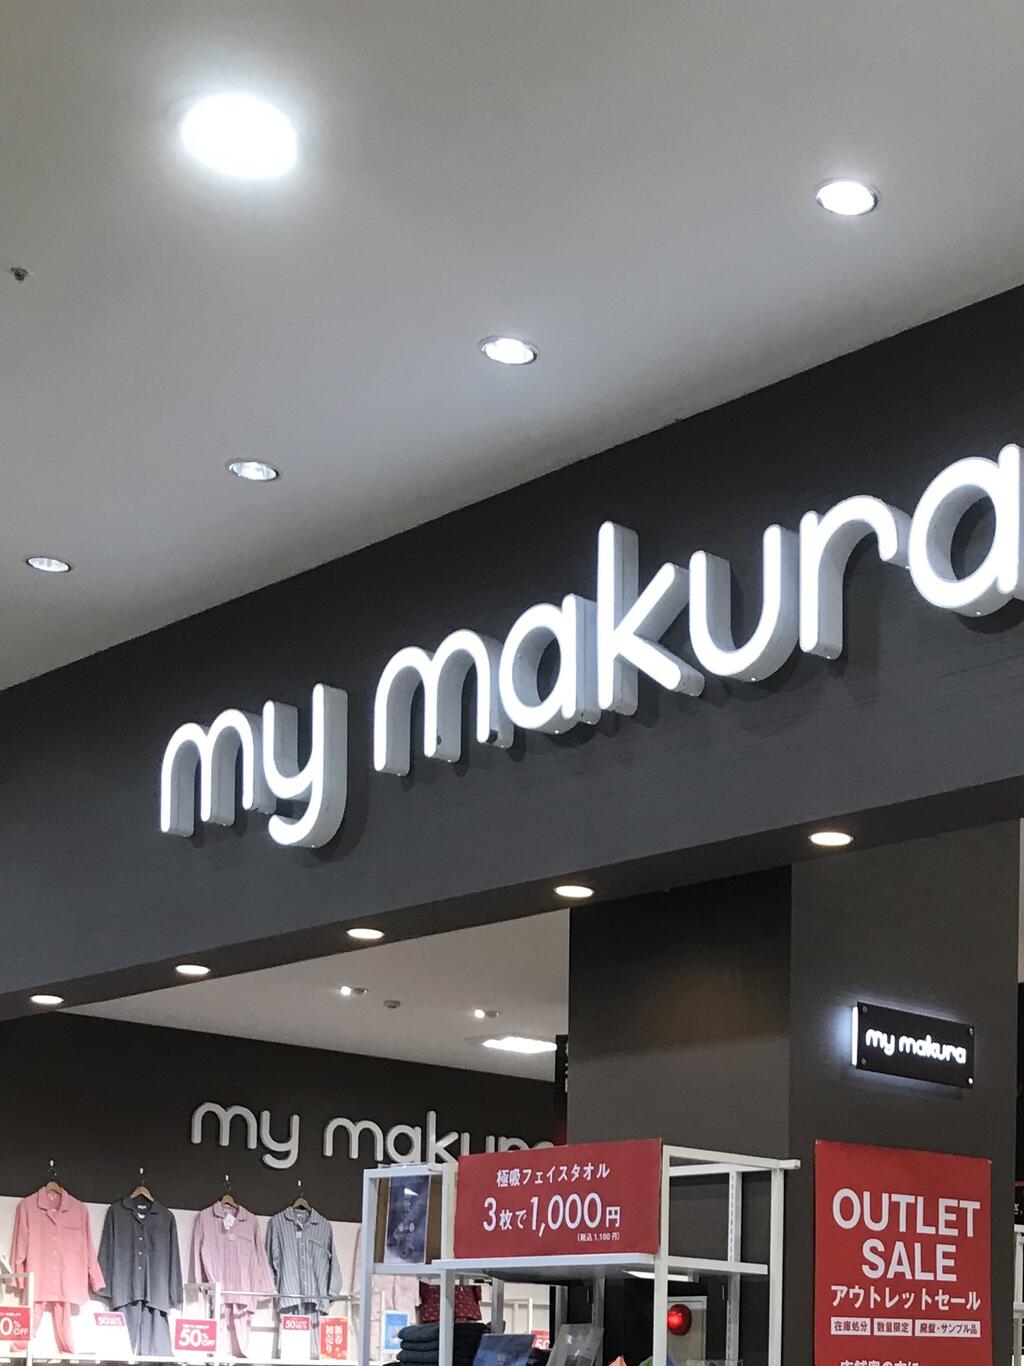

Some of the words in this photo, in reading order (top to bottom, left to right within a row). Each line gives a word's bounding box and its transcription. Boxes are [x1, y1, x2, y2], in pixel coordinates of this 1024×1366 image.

[161, 684, 340, 848] my
[865, 1028, 896, 1056] my
[898, 1034, 967, 1064] makura
[191, 1102, 299, 1169] my
[323, 1110, 553, 1165] mak
[496, 1163, 611, 1187] 極吸フェイスタオル
[832, 1187, 981, 1237] OUTLET
[861, 1239, 957, 1282] SALE
[831, 1285, 981, 1311] アウトレットセール
[834, 1321, 868, 1332] 在庫処分
[877, 1322, 909, 1333] 数量限定
